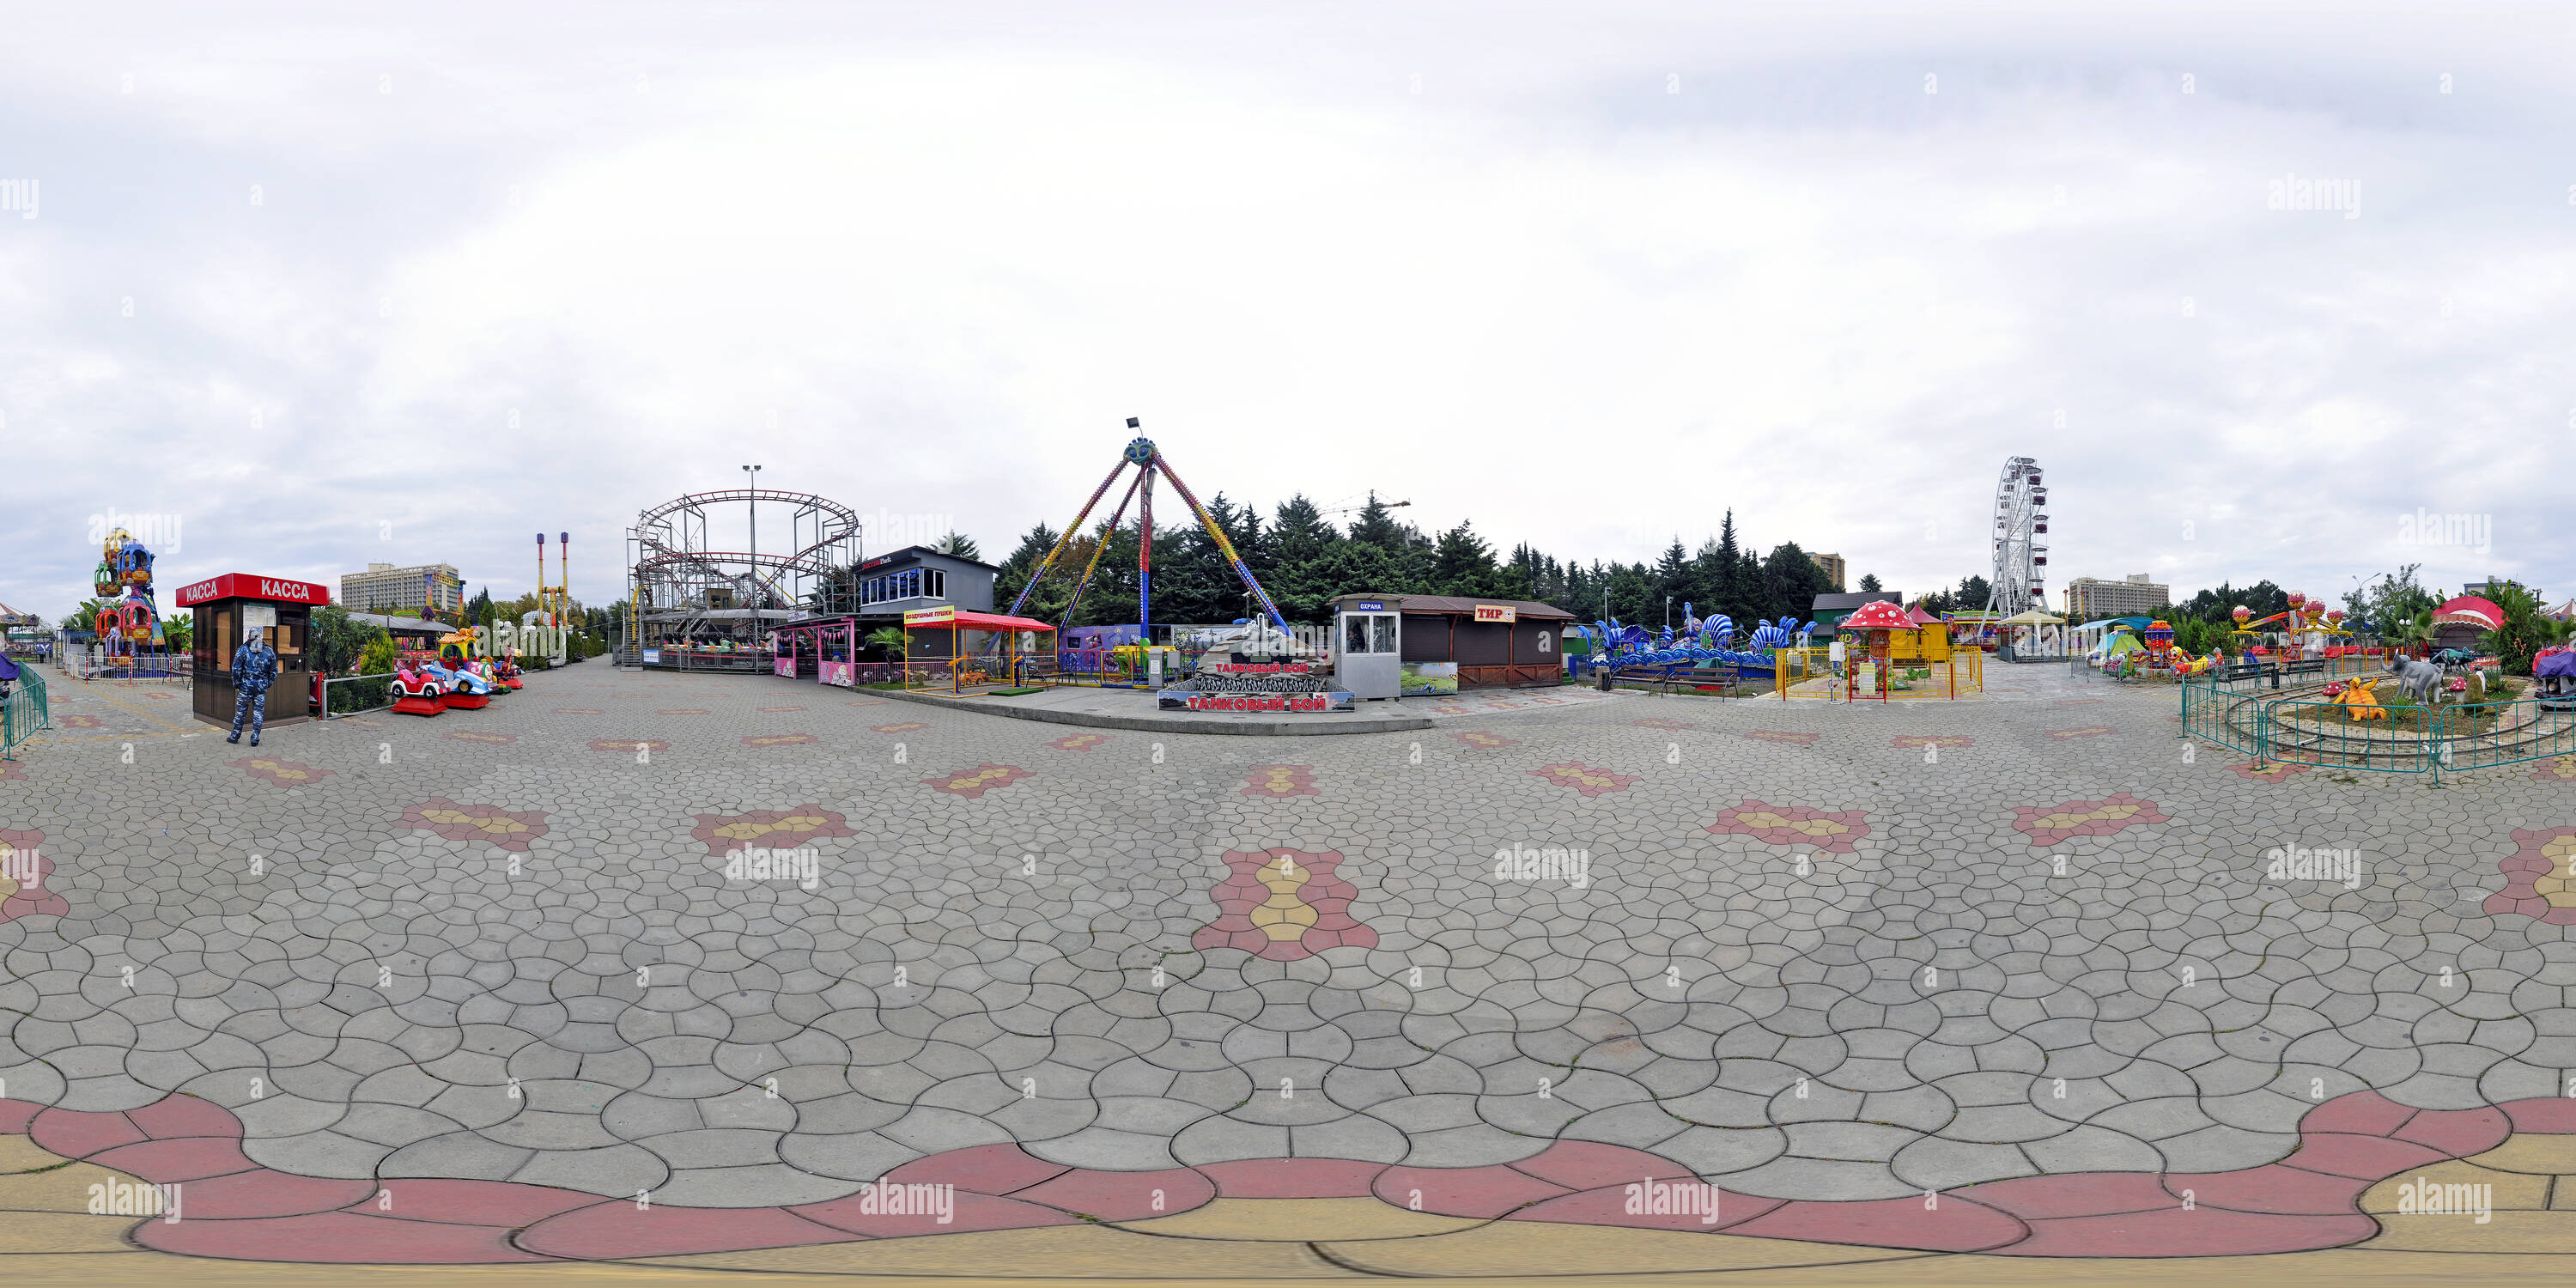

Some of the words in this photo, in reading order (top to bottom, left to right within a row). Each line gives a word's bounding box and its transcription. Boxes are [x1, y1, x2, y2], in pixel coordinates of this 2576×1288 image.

[186, 580, 217, 603] КАССА
[261, 579, 310, 600] КАССА
[905, 611, 933, 620] ВОЗДУШНЫЕ
[1477, 608, 1503, 619] ТИР
[1838, 634, 1852, 643] 4D
[1215, 661, 1280, 673] ТАНКОВЫЙ
[1284, 661, 1309, 673] БОЙ
[1188, 695, 1285, 711] ТАНКОВЫЙ
[1290, 695, 1327, 711] БОЙ
